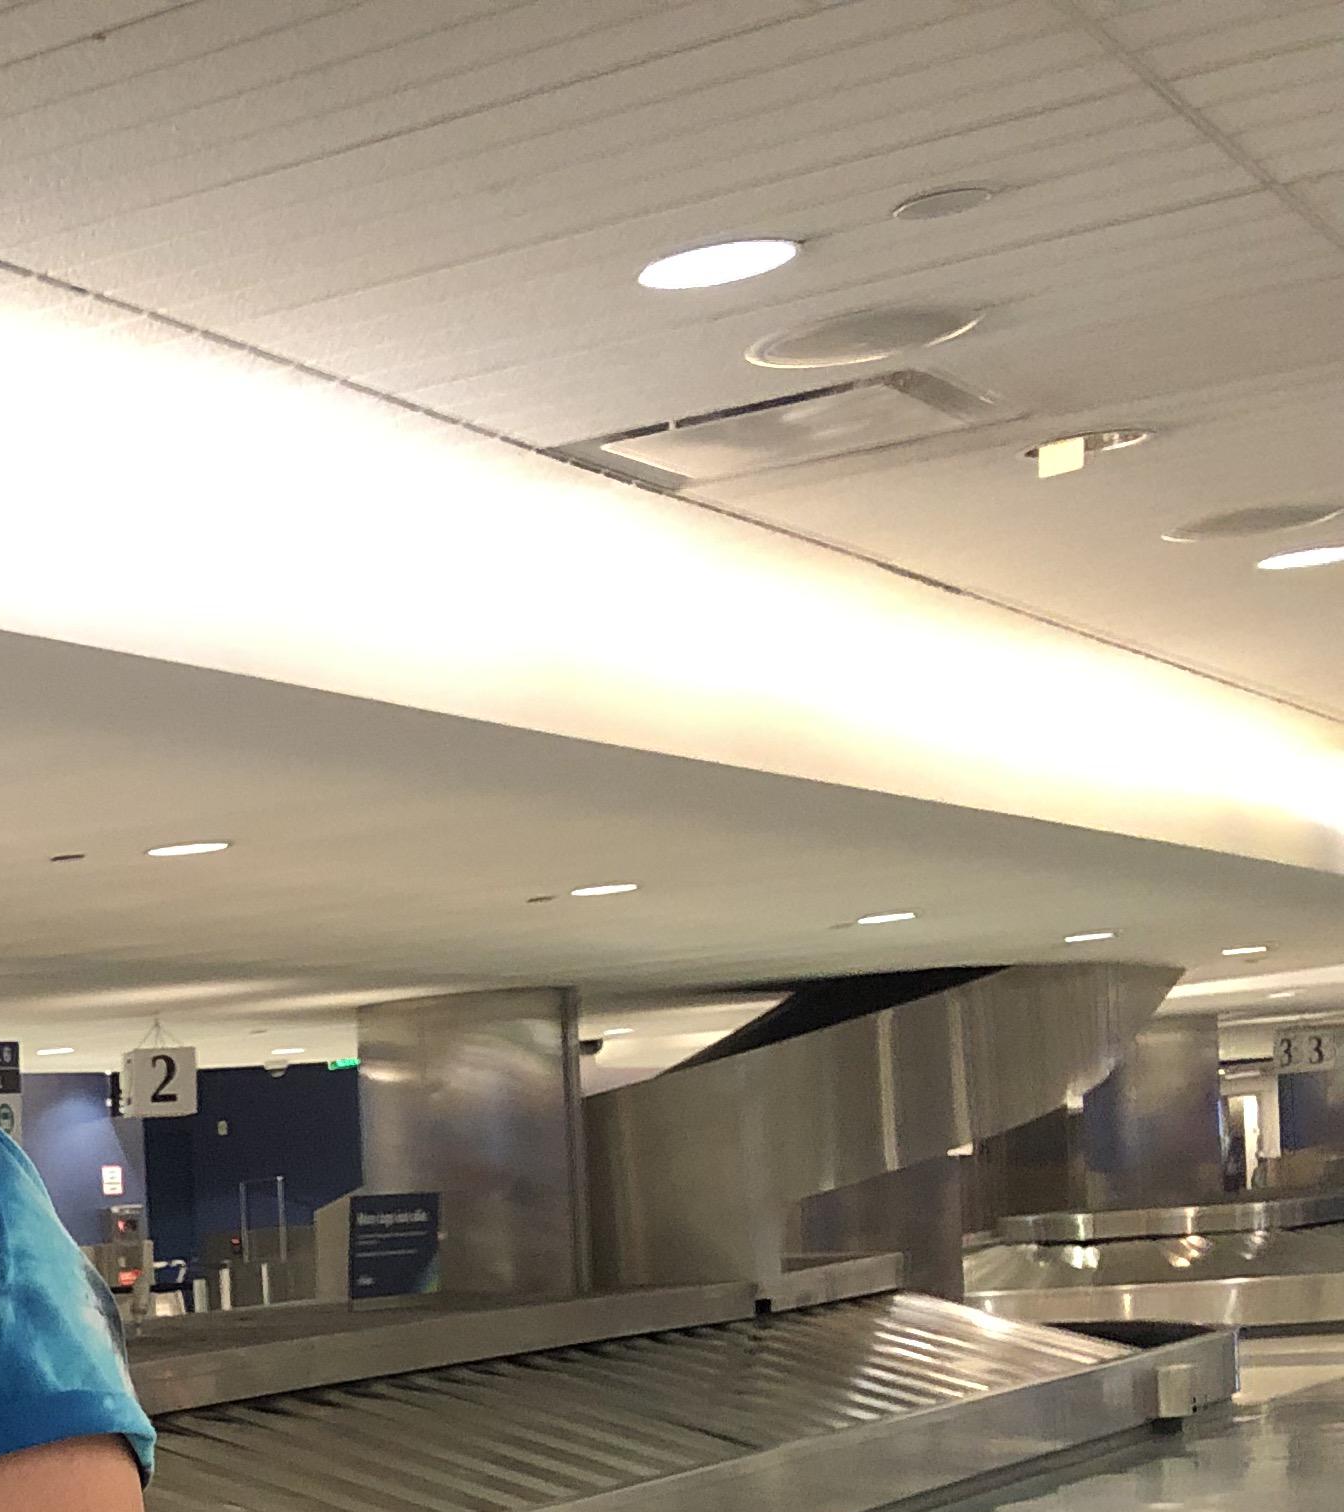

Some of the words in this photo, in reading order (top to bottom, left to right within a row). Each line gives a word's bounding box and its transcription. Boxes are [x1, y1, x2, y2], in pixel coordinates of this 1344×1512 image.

[1279, 1038, 1293, 1069] 3
[1308, 1036, 1324, 1065] 3
[151, 1054, 178, 1103] 2
